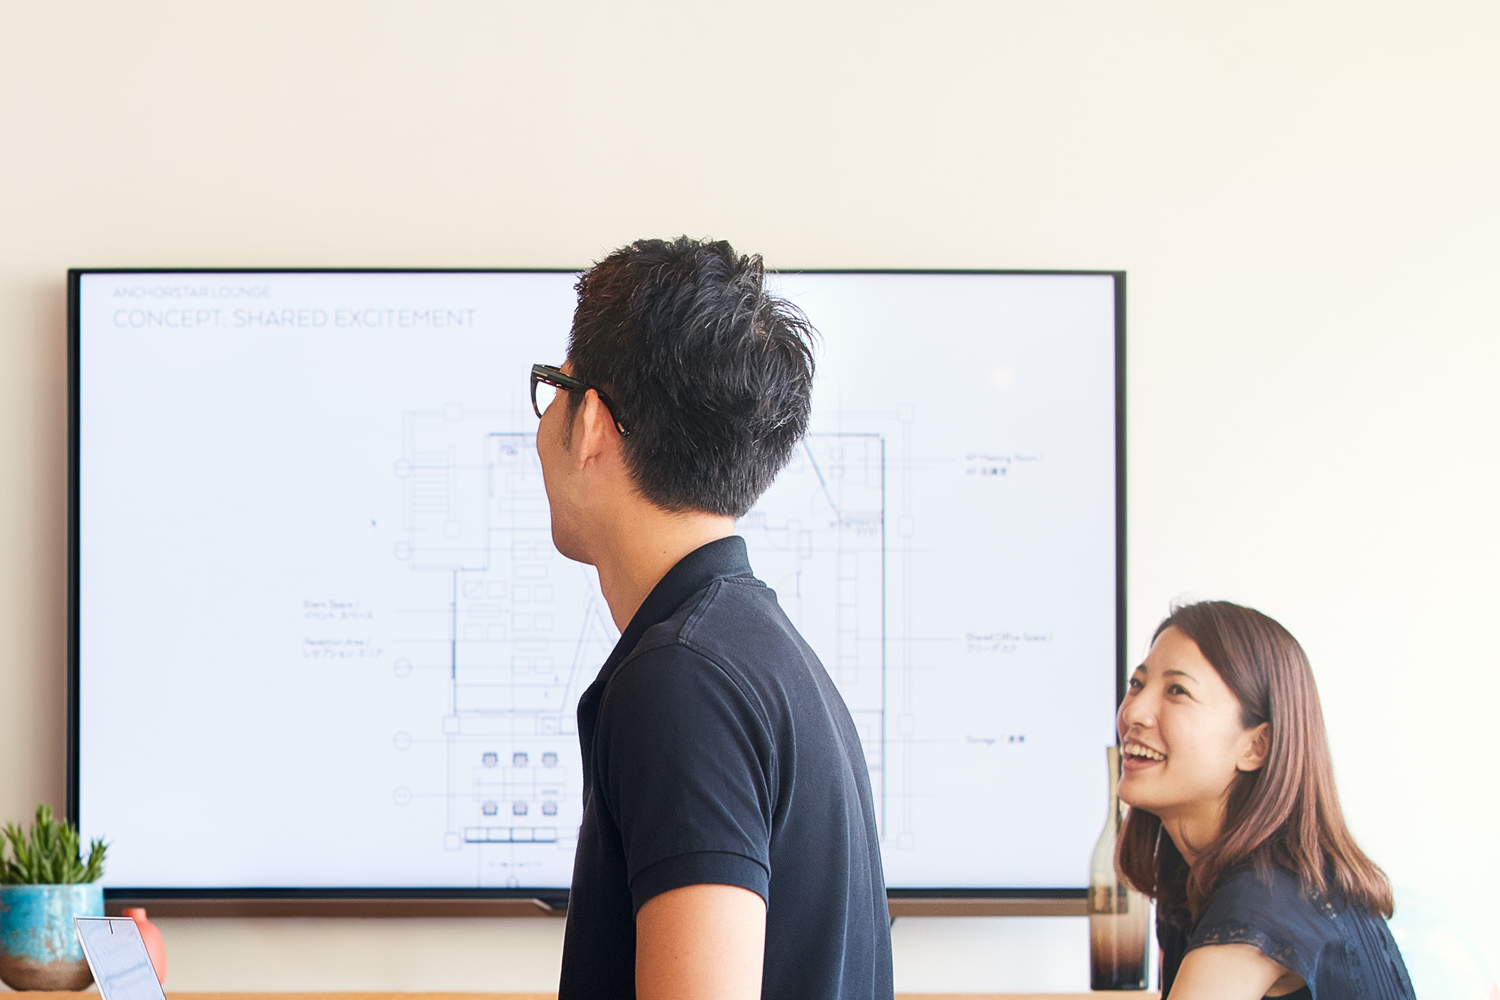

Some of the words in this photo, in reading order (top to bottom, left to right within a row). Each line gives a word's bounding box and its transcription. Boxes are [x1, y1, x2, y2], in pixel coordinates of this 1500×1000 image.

[211, 285, 272, 299] LOUNGE
[112, 308, 227, 329] CONCEPT:
[233, 308, 329, 329] SHARED
[334, 308, 478, 329] EXCITEMENT
